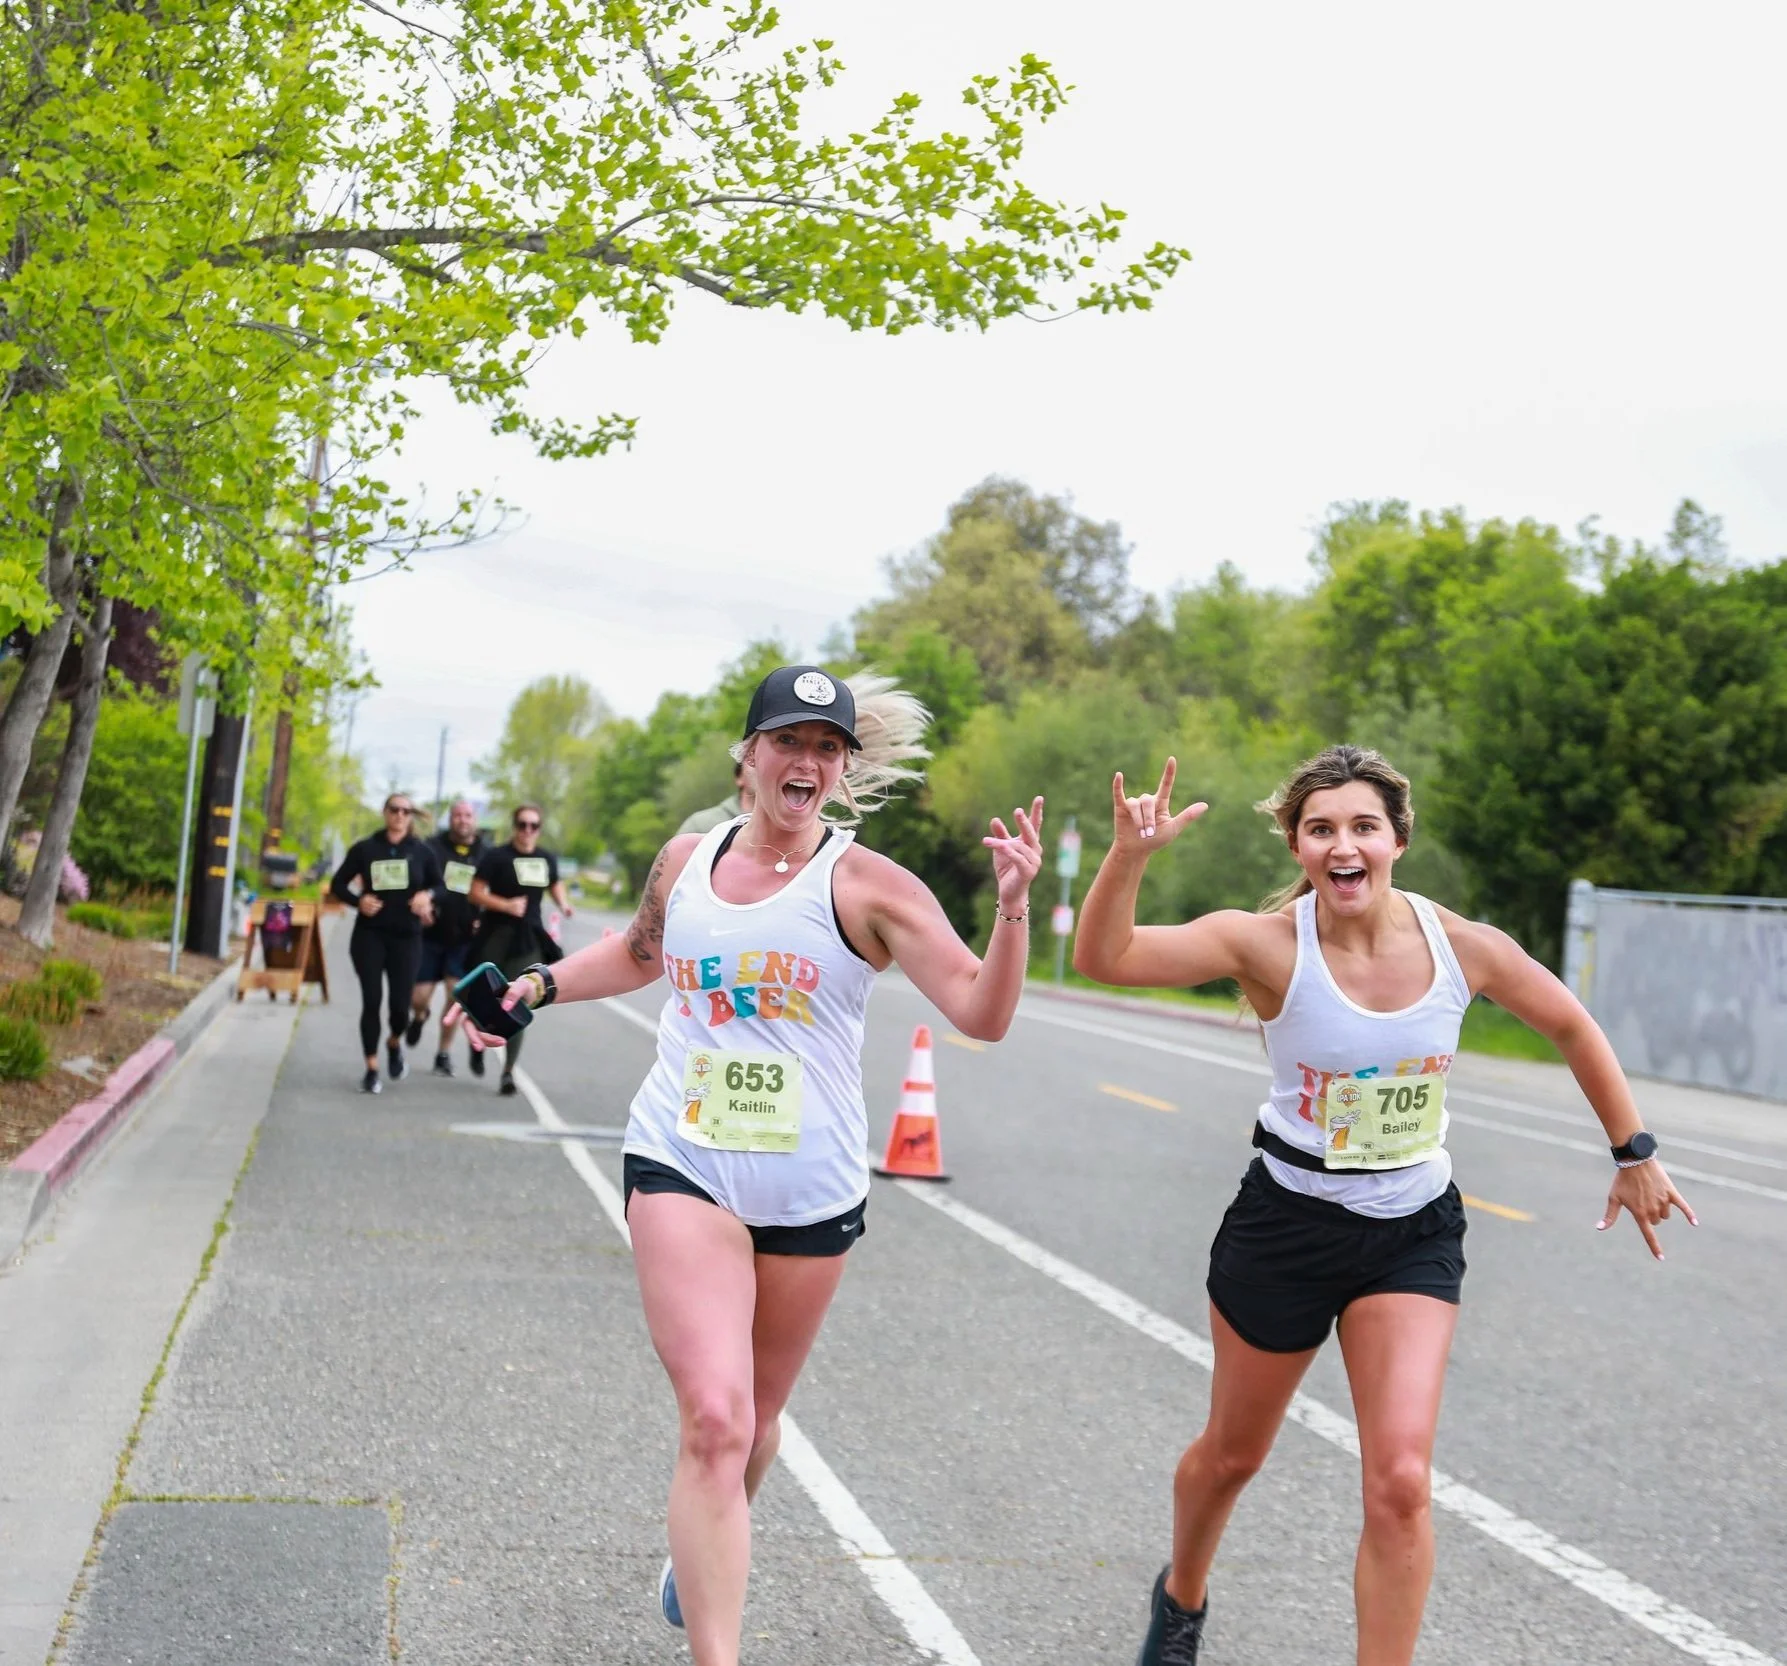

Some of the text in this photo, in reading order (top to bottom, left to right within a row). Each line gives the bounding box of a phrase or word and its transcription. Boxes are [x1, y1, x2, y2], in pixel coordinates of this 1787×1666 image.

[665, 951, 819, 993] THE END
[707, 986, 816, 1028] BEER
[726, 1061, 784, 1093] 653
[729, 1099, 776, 1114] Kaitlin
[1377, 1084, 1430, 1115] 705
[1382, 1119, 1422, 1135] Bailey
